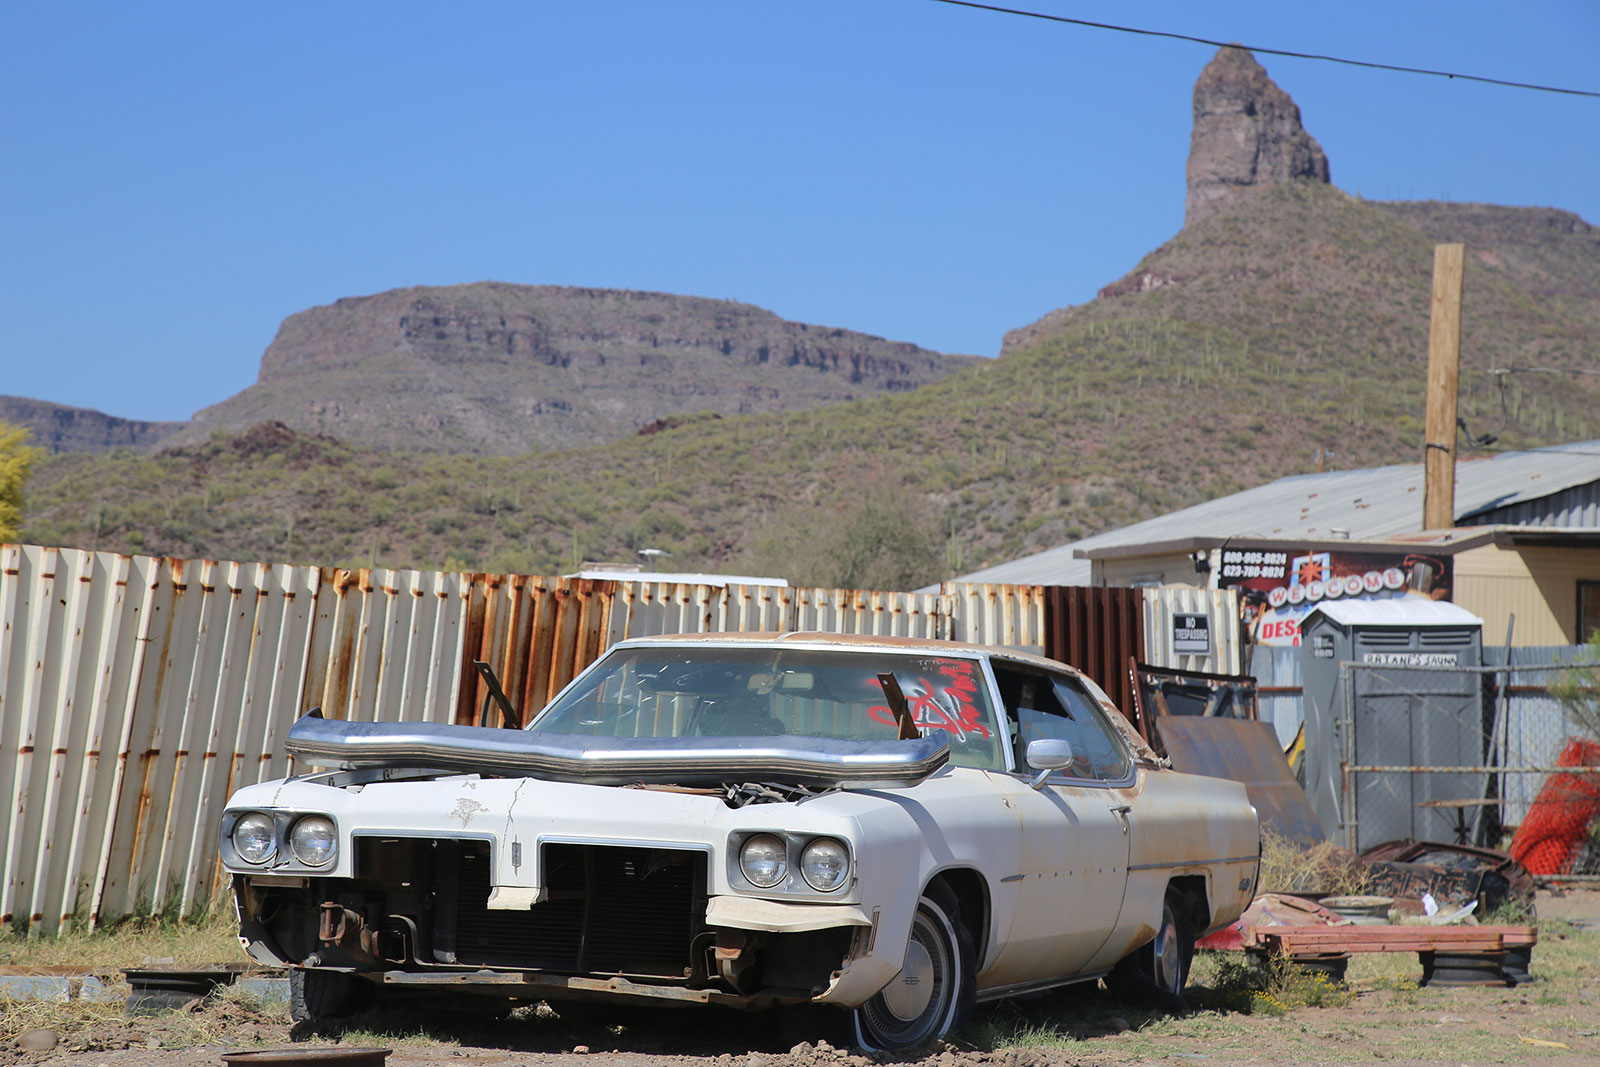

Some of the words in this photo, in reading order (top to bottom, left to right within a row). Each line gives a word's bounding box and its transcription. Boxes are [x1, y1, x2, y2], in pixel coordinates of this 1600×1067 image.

[1272, 571, 1399, 603] WELCOME
[1185, 617, 1196, 629] NO
[1425, 654, 1458, 667] SAUNA
